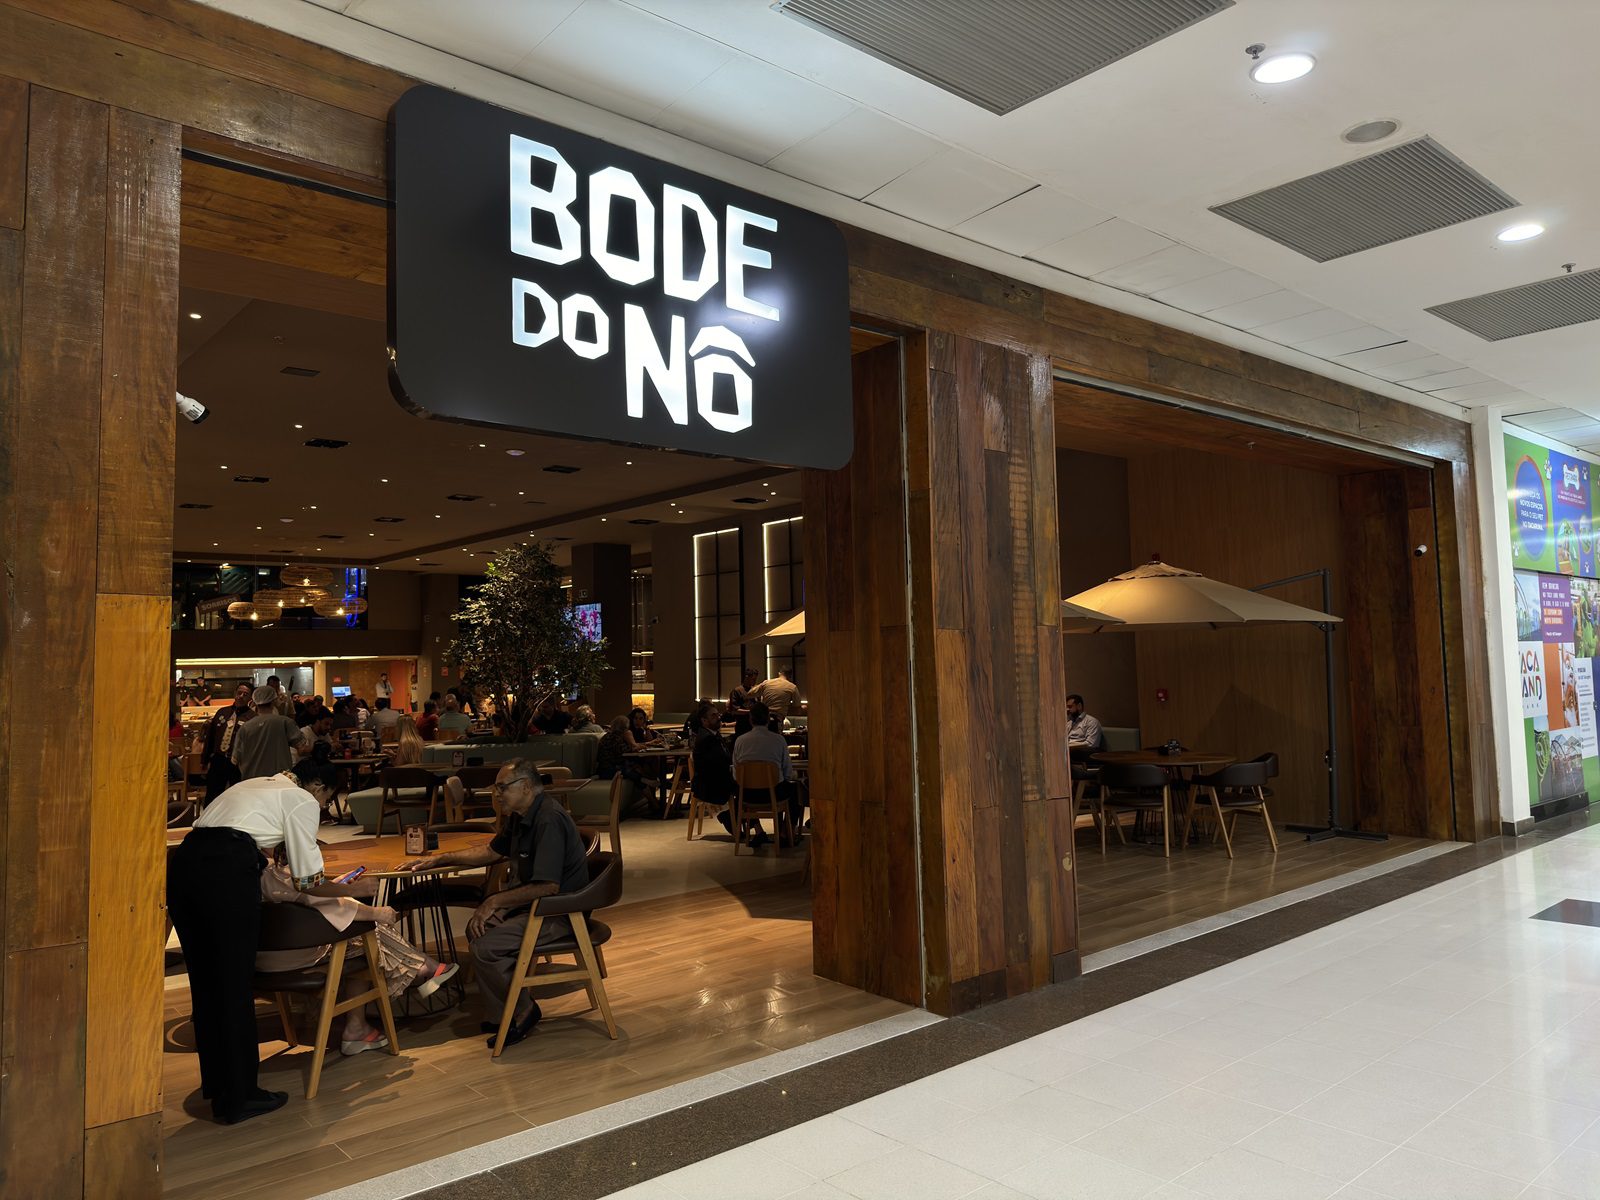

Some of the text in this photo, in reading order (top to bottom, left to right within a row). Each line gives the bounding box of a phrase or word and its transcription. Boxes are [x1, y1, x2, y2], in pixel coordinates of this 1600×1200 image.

[510, 133, 780, 322] BODE
[512, 277, 756, 434] DO NÔ
[1519, 650, 1540, 674] ACA
[1522, 676, 1542, 700] AND
